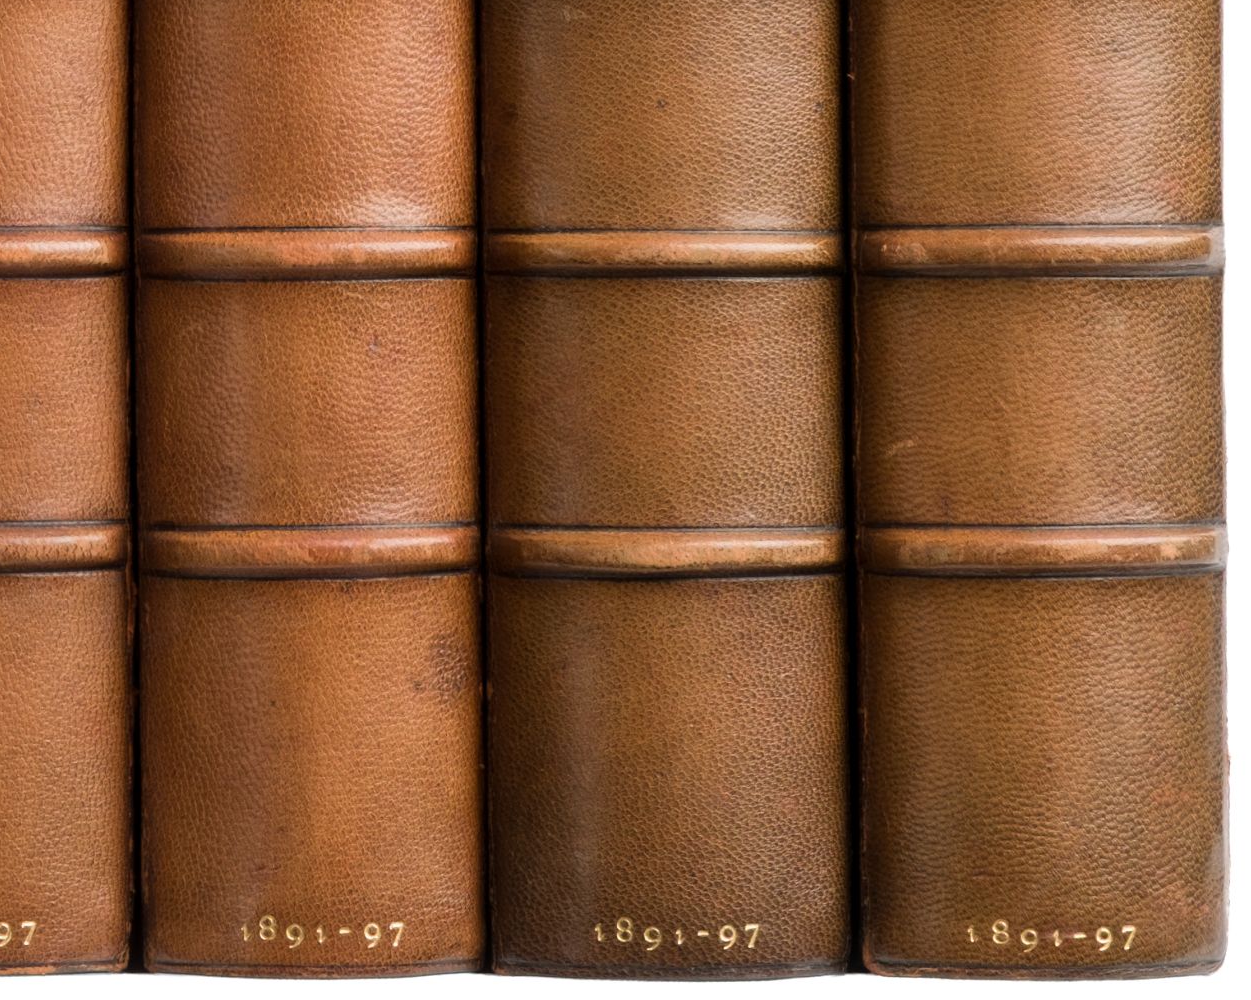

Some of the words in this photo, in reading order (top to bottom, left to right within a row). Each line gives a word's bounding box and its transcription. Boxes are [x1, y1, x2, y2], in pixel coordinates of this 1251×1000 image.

[240, 915, 407, 949] 1891-97
[594, 917, 762, 952] 1891-97
[966, 919, 1137, 954] 1891-97
